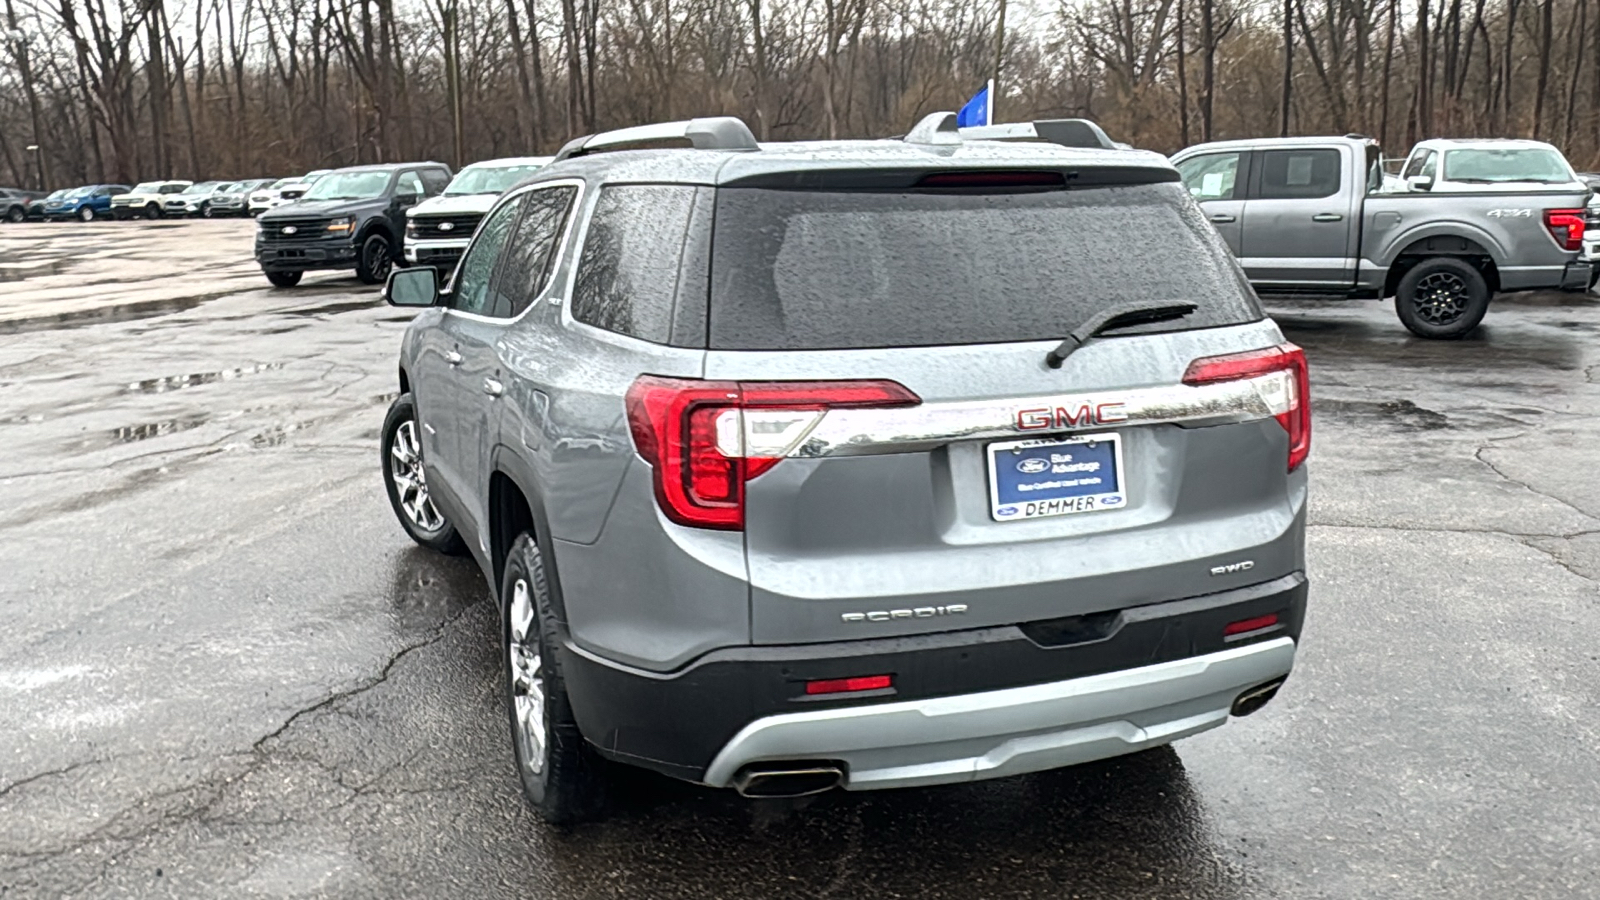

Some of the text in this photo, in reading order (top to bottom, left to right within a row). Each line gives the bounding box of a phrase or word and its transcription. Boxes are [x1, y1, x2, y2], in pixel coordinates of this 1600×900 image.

[1017, 402, 1128, 430] GMC
[1051, 453, 1072, 463] Blue
[1051, 462, 1100, 473] Advantage
[1025, 496, 1095, 516] DEMMER
[1210, 560, 1254, 575] AWD
[841, 604, 968, 622] ACADIA
